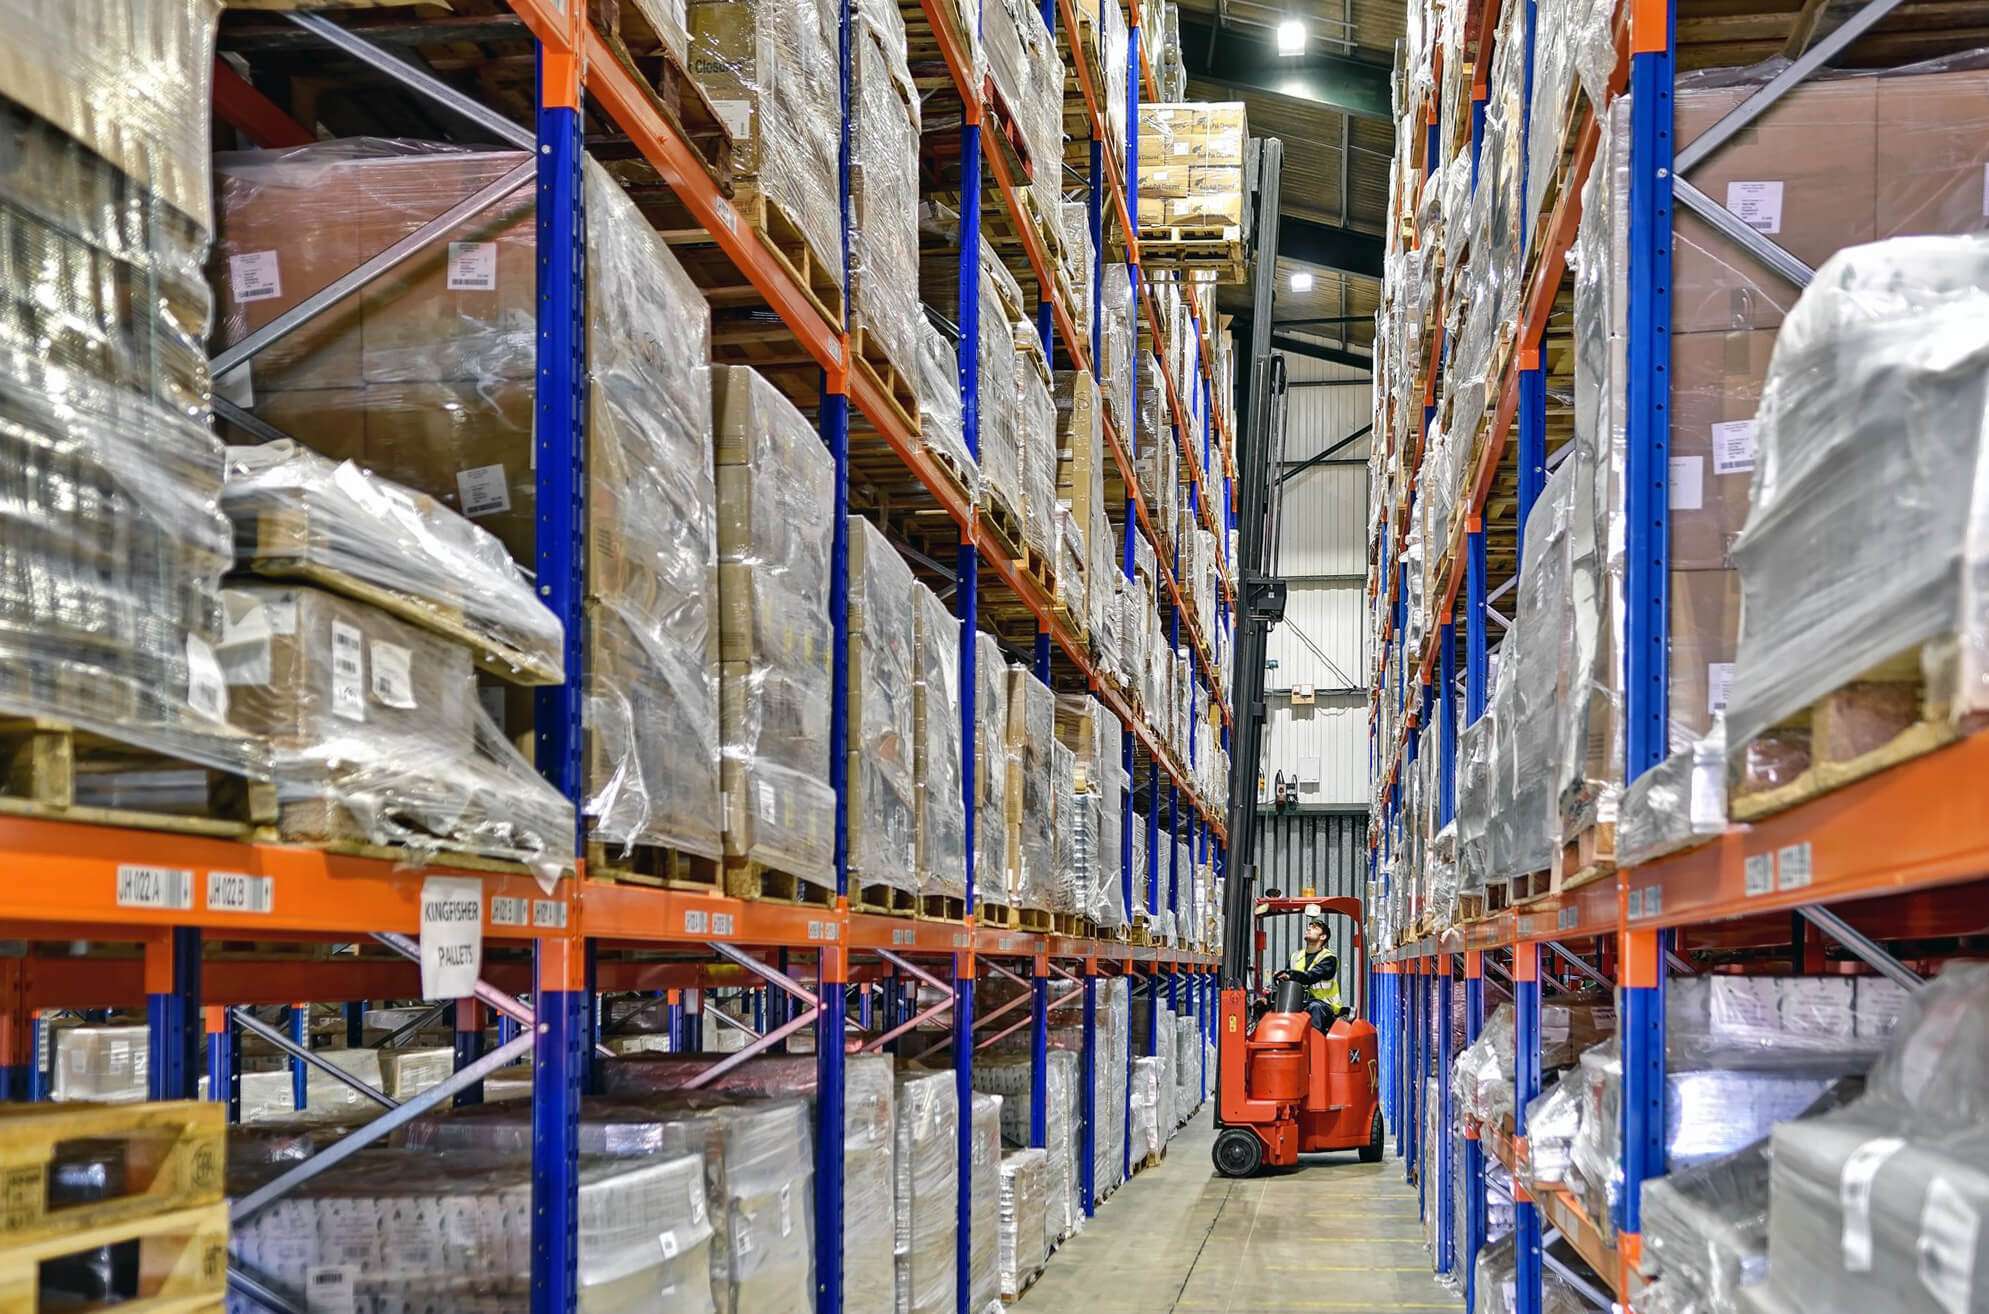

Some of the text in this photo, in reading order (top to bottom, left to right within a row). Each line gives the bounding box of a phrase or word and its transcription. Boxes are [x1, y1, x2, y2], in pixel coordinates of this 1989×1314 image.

[134, 871, 150, 902] 022
[153, 873, 160, 902] A
[222, 876, 237, 906] 022
[425, 901, 479, 922] KINGFISHER
[438, 943, 473, 968] PALLETS
